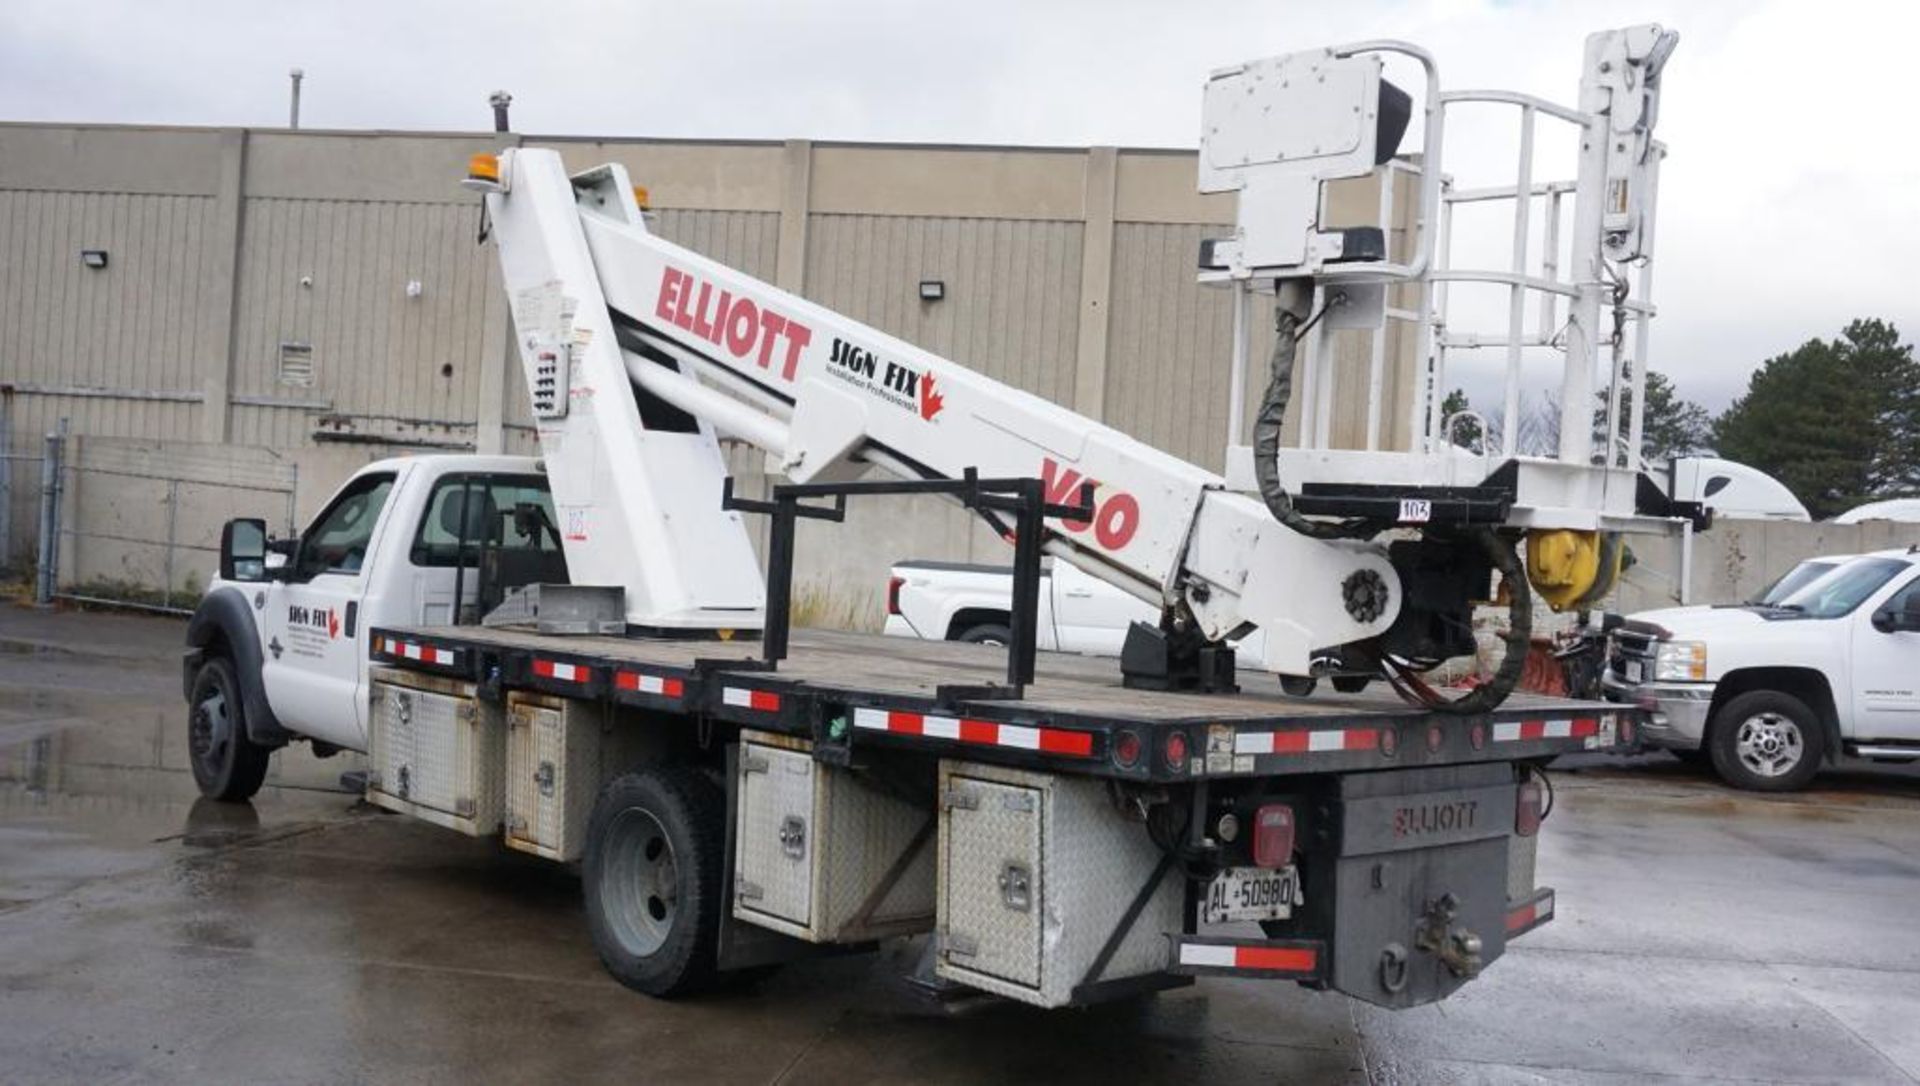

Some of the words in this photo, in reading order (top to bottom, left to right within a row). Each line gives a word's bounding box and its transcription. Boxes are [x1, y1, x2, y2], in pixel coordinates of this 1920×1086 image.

[655, 265, 812, 382] ELLIOTT
[830, 337, 878, 379] SIGN
[883, 361, 920, 398] FIX
[1404, 502, 1428, 518] 103
[1395, 801, 1478, 836] ELLIOTT
[1211, 882, 1230, 912] AL
[1241, 878, 1291, 908] 50980
